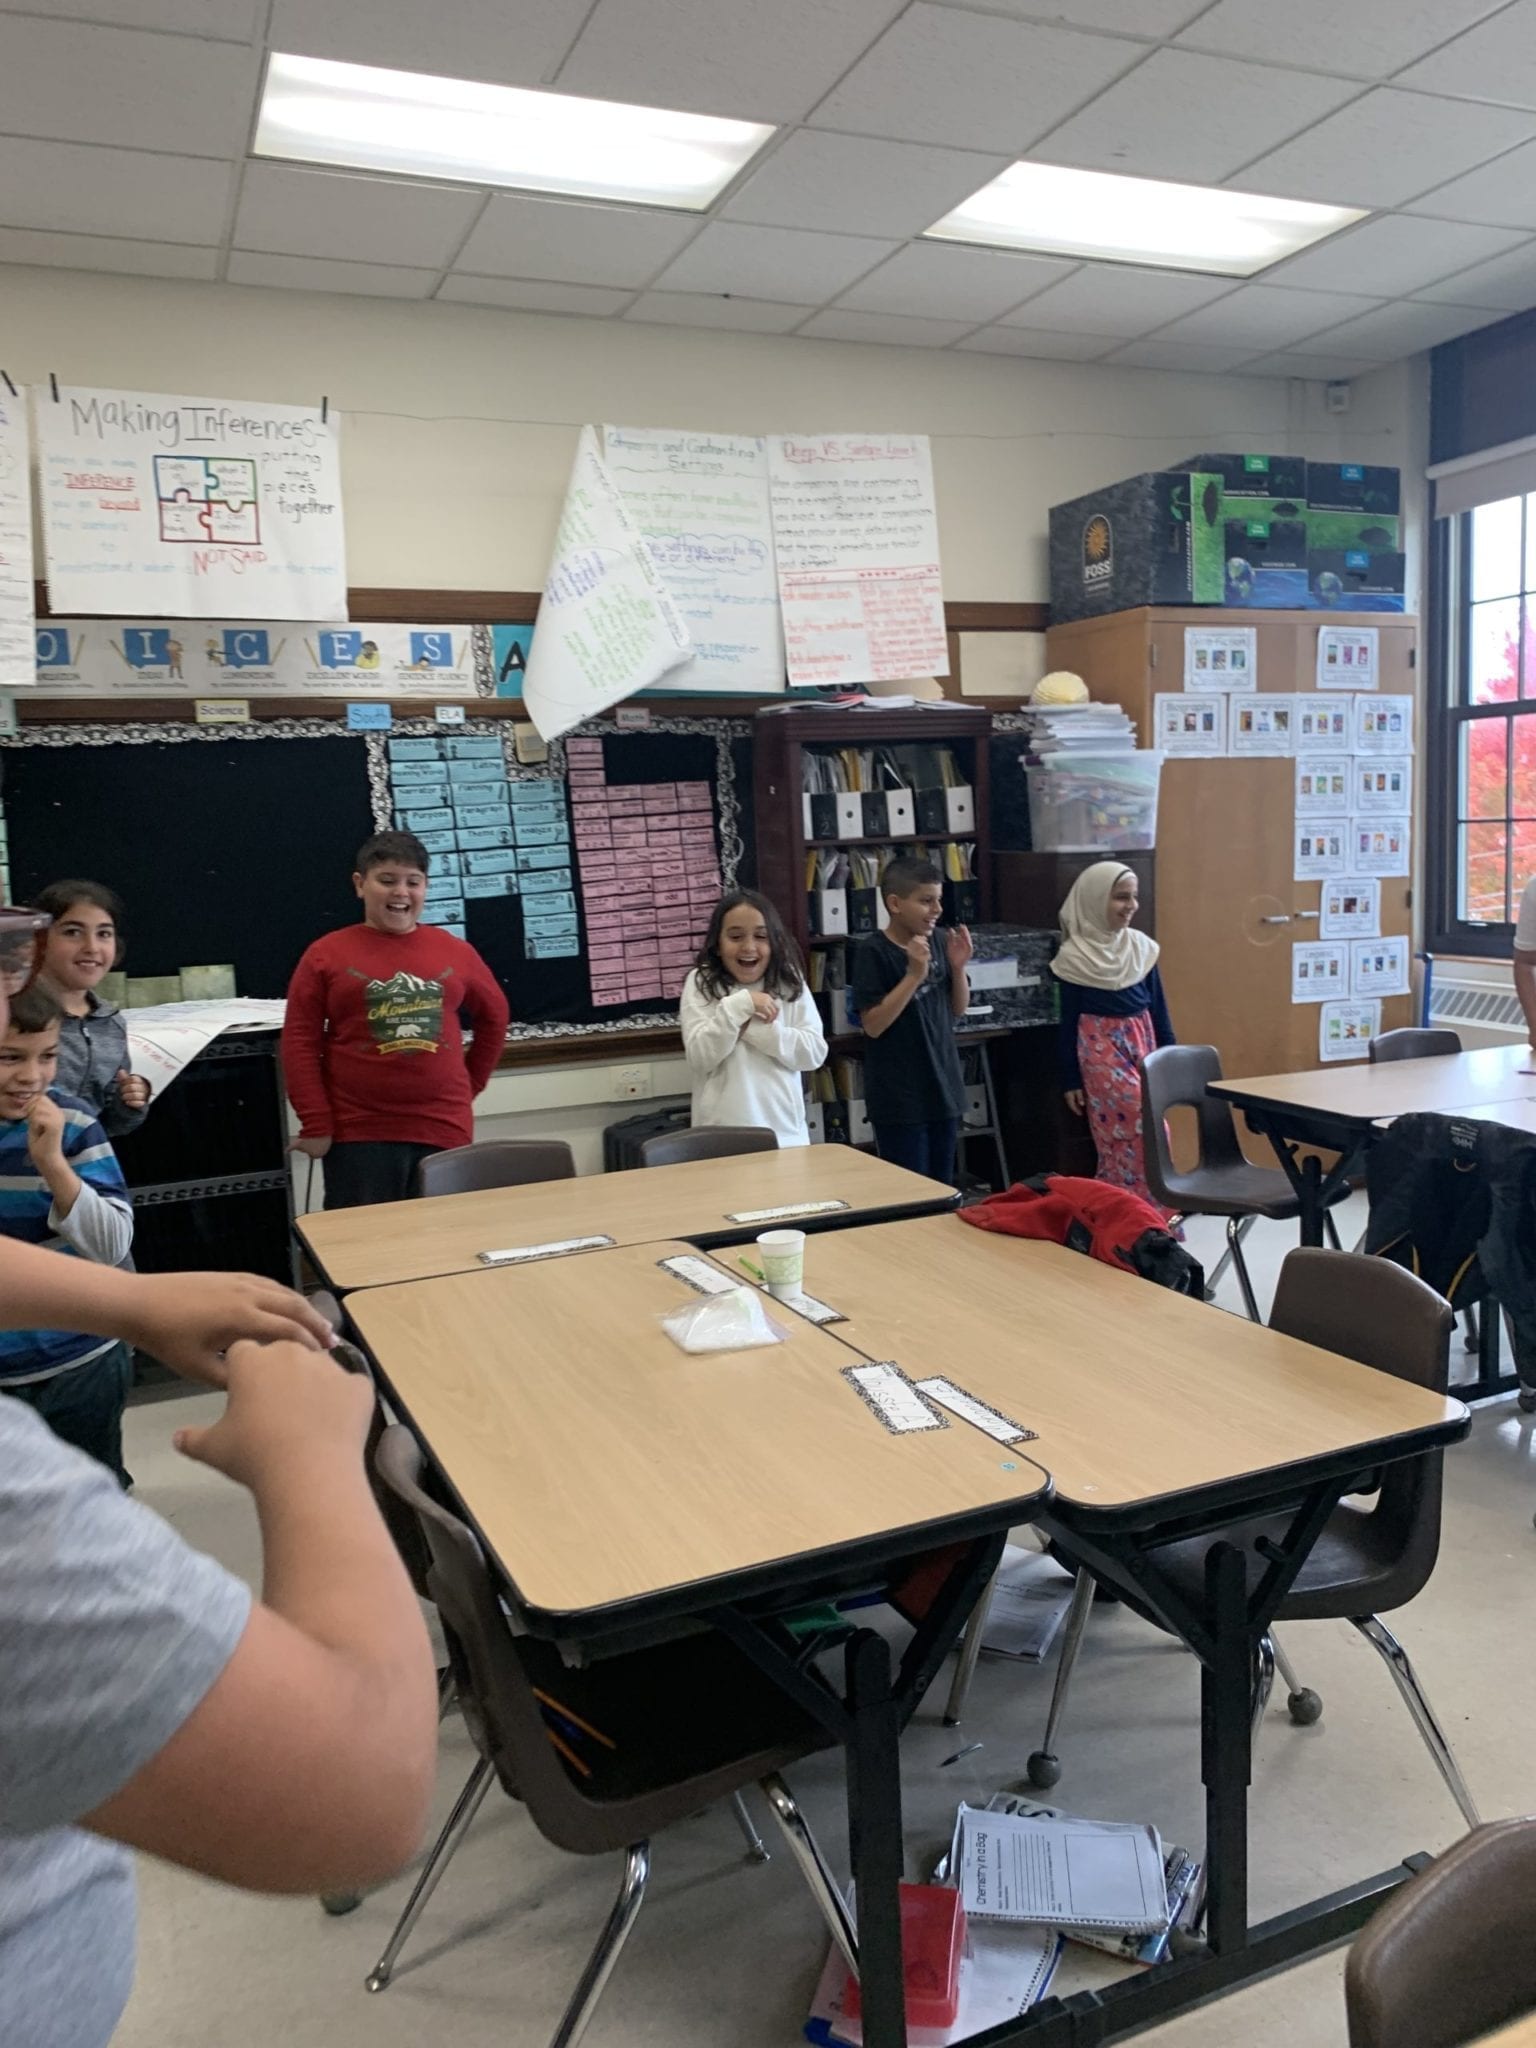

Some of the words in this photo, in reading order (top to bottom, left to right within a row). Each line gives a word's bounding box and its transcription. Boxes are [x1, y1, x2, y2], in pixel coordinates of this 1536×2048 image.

[70, 397, 180, 448] Making
[261, 451, 322, 472] putting
[277, 496, 336, 524] together
[1085, 560, 1112, 579] FOSS
[36, 631, 58, 662] O
[138, 631, 156, 660] I
[233, 632, 259, 661] C
[330, 632, 353, 661] E
[422, 633, 442, 661] S
[500, 640, 525, 684] A
[201, 704, 245, 717] Science
[440, 707, 462, 720] ELA
[822, 821, 831, 834] 2
[870, 820, 880, 831] 4
[976, 1832, 988, 1848] Bag
[976, 1855, 986, 1863] in
[976, 1863, 988, 1905] Chemistry
